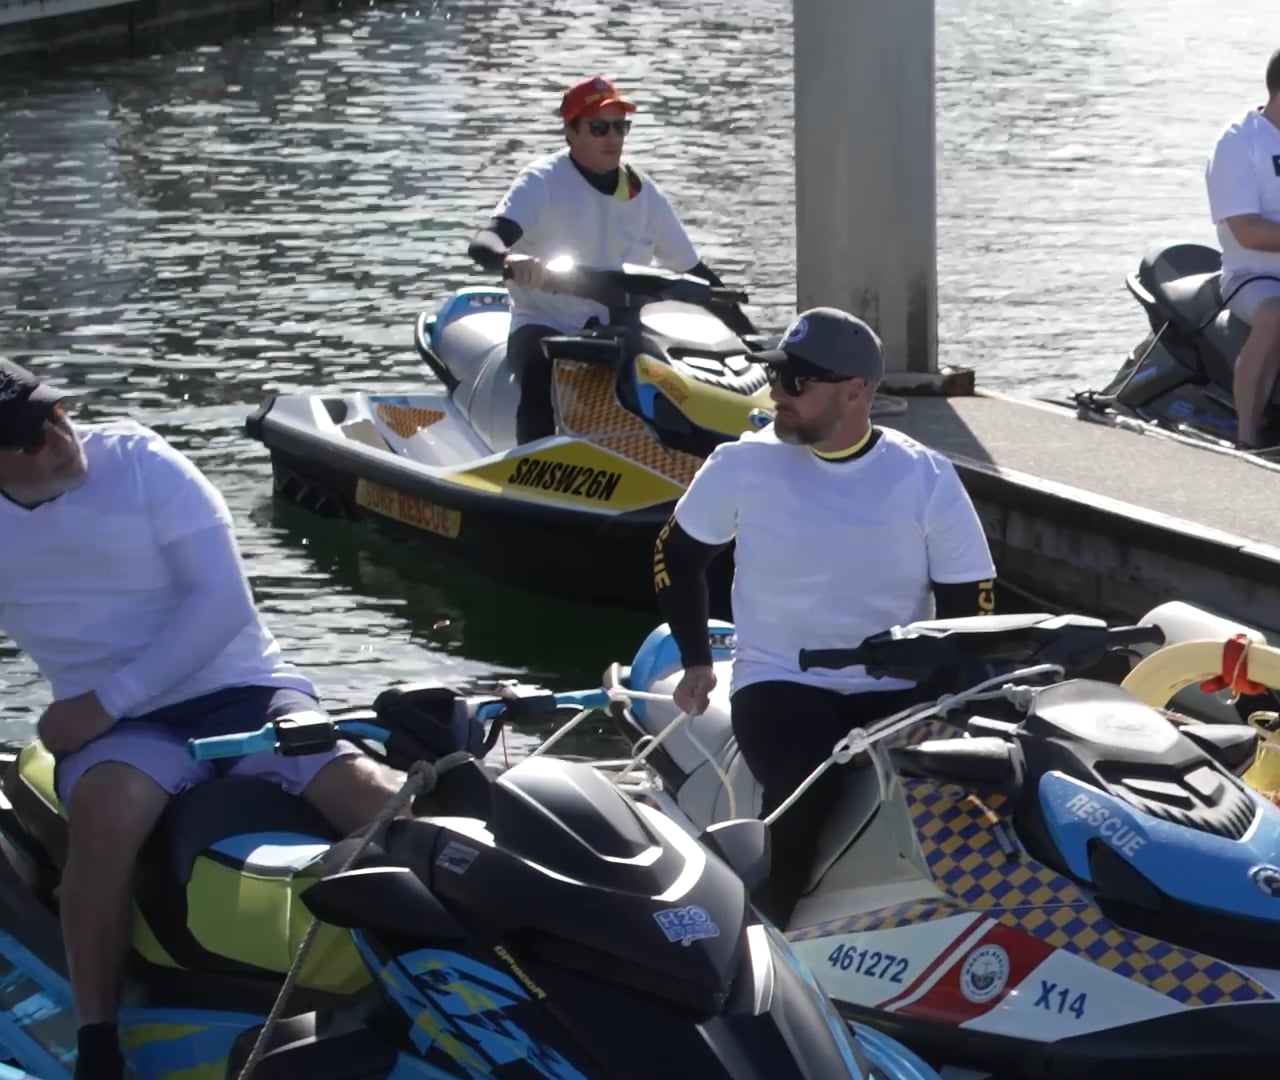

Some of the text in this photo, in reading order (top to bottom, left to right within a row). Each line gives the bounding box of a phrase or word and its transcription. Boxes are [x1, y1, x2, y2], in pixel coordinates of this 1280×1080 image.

[508, 457, 622, 501] SRNSW26N
[1065, 794, 1146, 857] RESCUE
[828, 944, 909, 983] 461272
[1033, 980, 1088, 1019] X14
